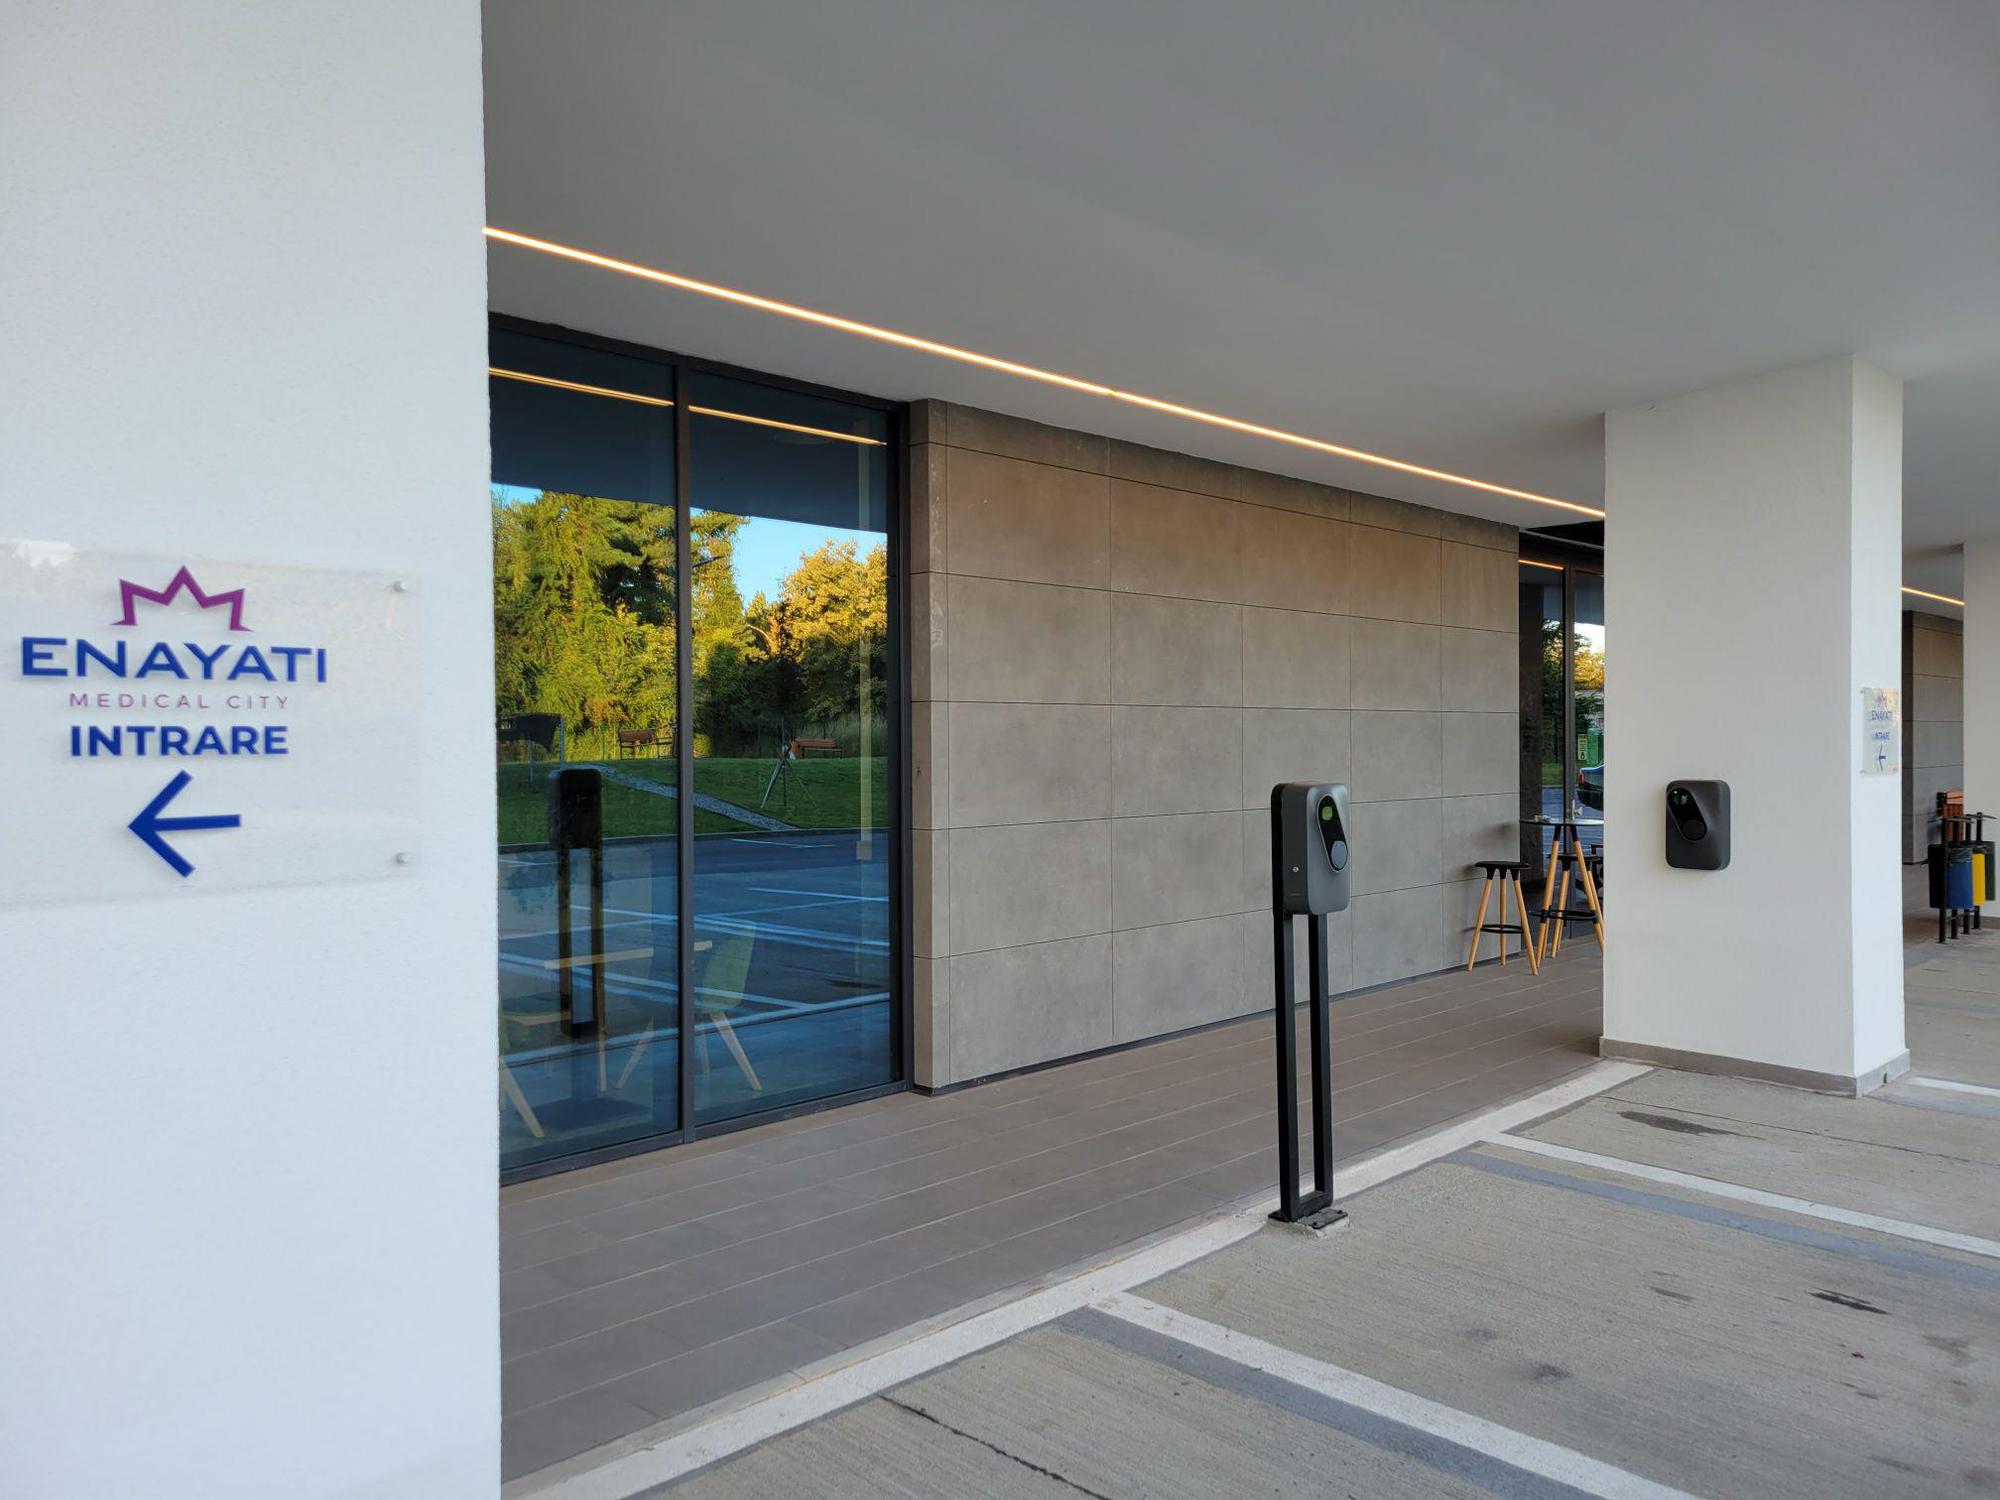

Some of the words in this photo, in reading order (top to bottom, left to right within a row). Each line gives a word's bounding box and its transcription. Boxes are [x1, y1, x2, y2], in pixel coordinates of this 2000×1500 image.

[21, 636, 327, 683] ENAYATI
[69, 692, 210, 709] MEDICAL
[226, 695, 289, 709] CITY
[69, 725, 289, 757] INTRARE
